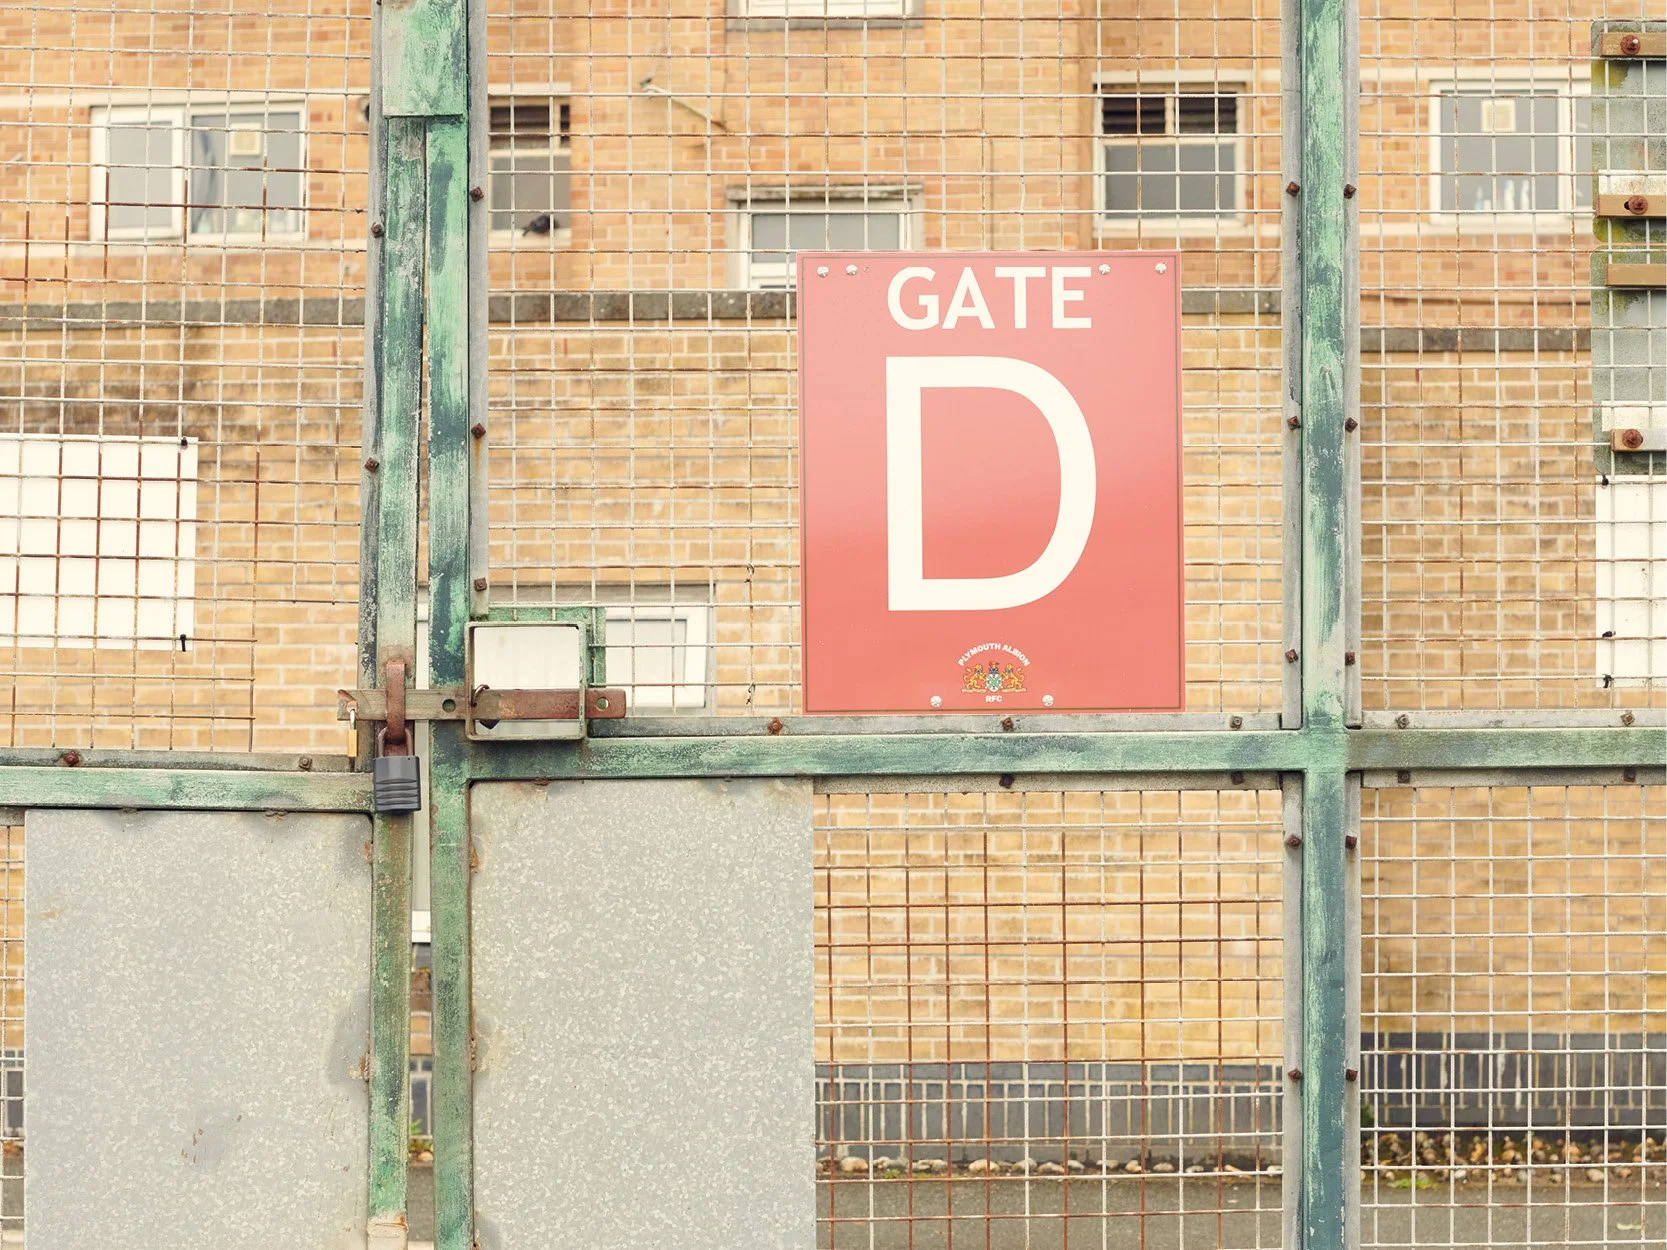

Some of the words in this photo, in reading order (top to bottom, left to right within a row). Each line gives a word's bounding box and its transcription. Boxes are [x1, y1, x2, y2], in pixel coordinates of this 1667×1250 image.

[886, 265, 1093, 331] GATE
[885, 355, 1097, 612] D
[957, 642, 1001, 667] PLYMOUTH
[1002, 644, 1031, 667] ALBION
[985, 695, 1003, 703] RFC
